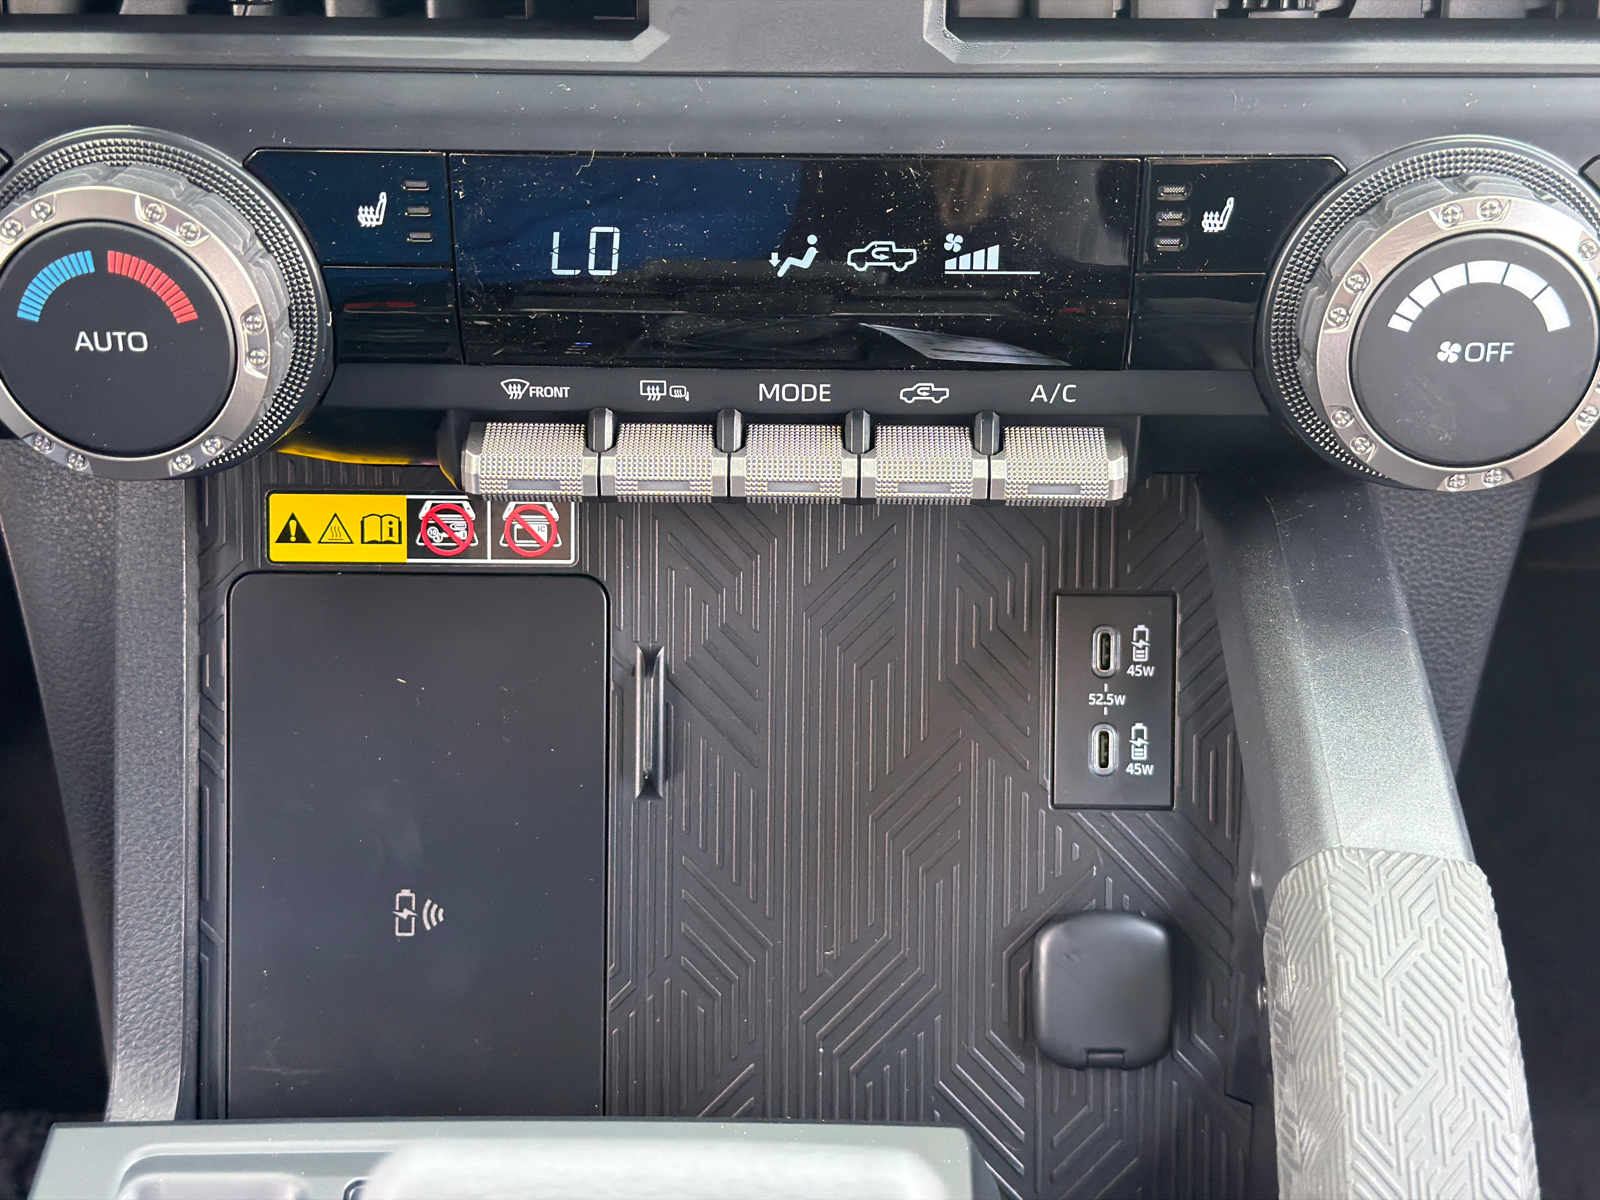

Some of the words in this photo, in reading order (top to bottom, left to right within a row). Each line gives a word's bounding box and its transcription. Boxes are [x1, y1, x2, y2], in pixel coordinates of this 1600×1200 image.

[551, 226, 620, 276] LO
[75, 331, 148, 352] AUTO
[1464, 341, 1515, 363] OFF
[529, 386, 570, 398] FRONT
[758, 383, 832, 402] MODE
[1030, 384, 1077, 403] A/C
[537, 525, 546, 533] IC
[1126, 664, 1155, 677] 45W
[1088, 693, 1126, 706] 52.5W
[1125, 762, 1154, 775] 45W
